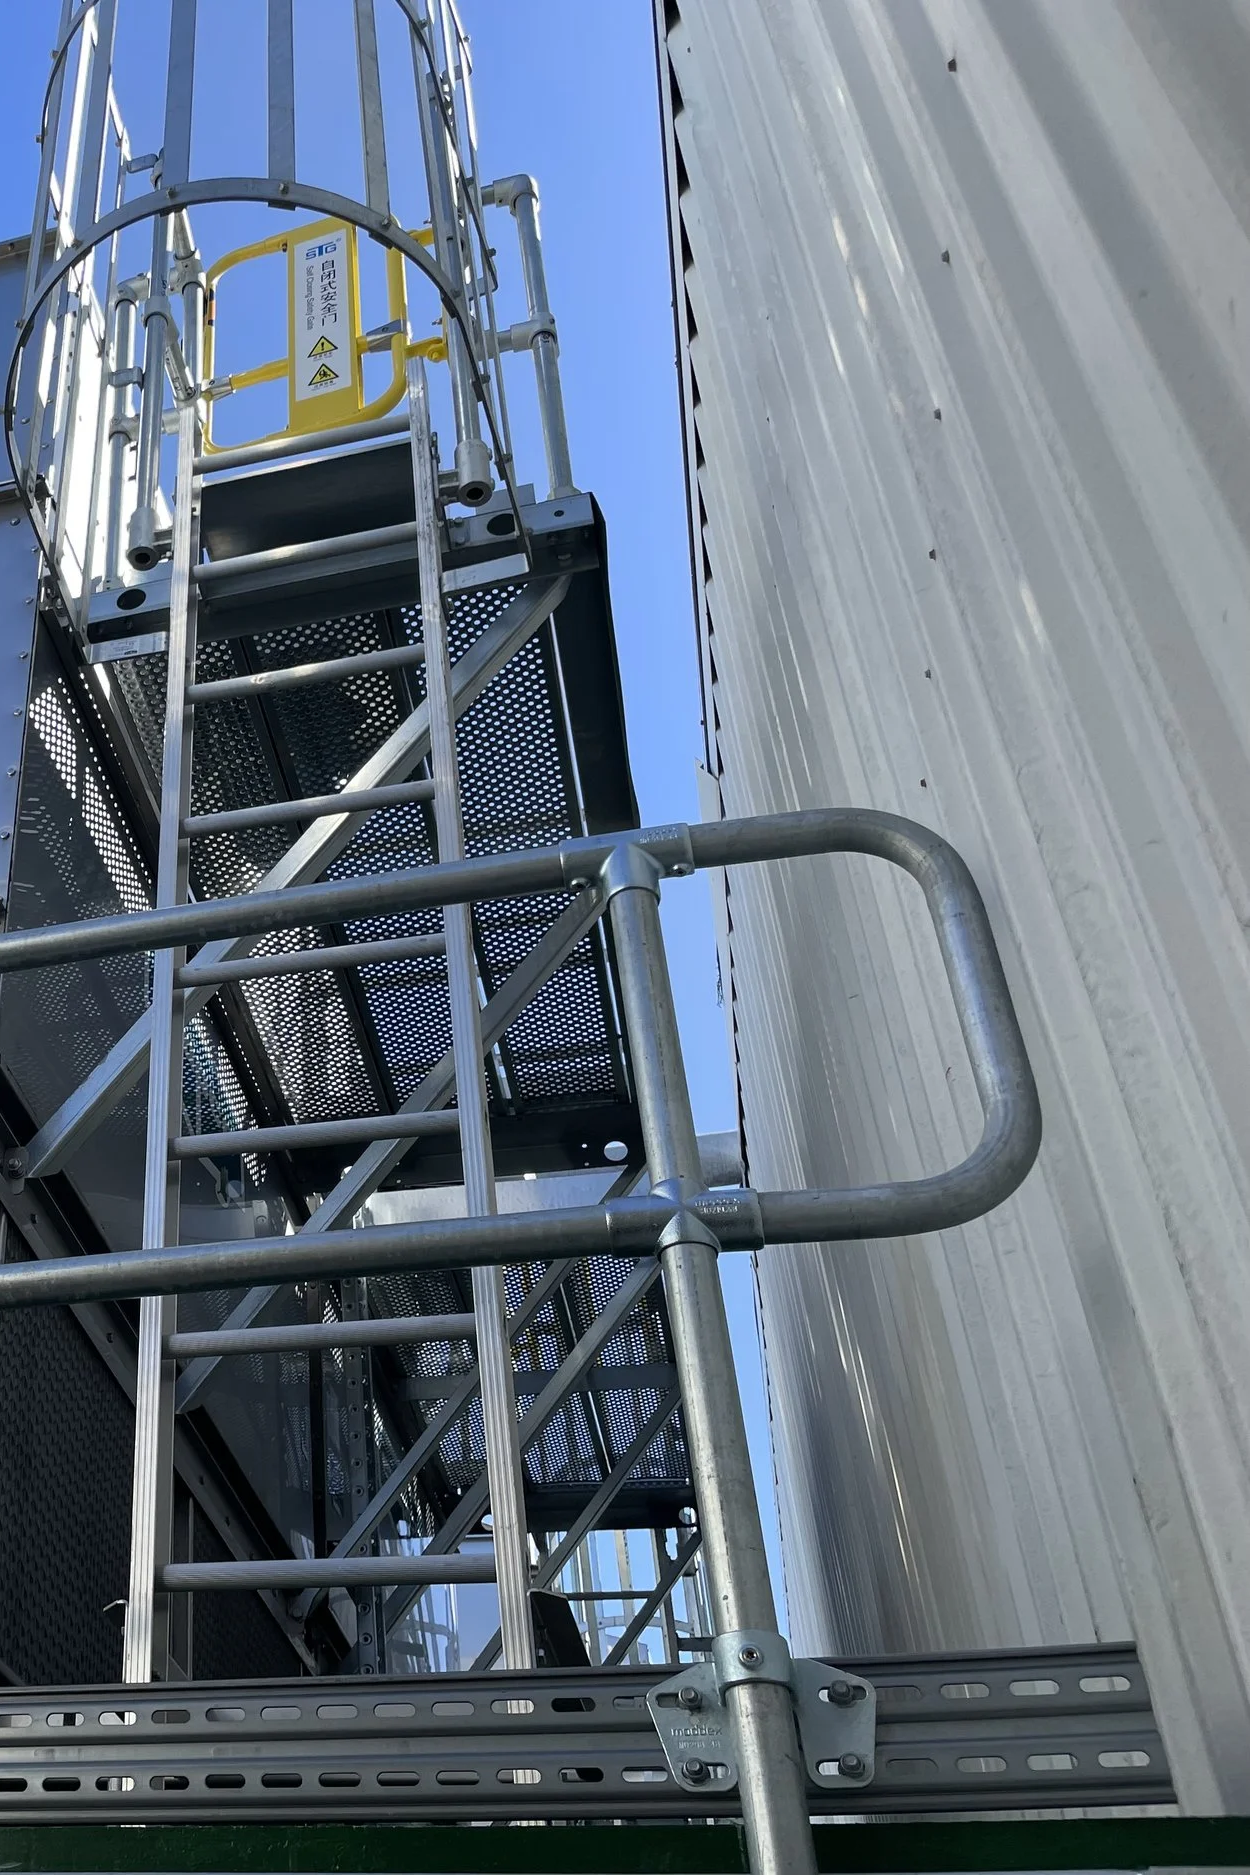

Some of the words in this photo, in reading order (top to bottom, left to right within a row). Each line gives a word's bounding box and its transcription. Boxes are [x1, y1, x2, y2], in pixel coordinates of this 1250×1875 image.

[305, 241, 337, 260] STG
[320, 259, 337, 326] 自闭式安全门
[670, 1725, 722, 1737] moddex
